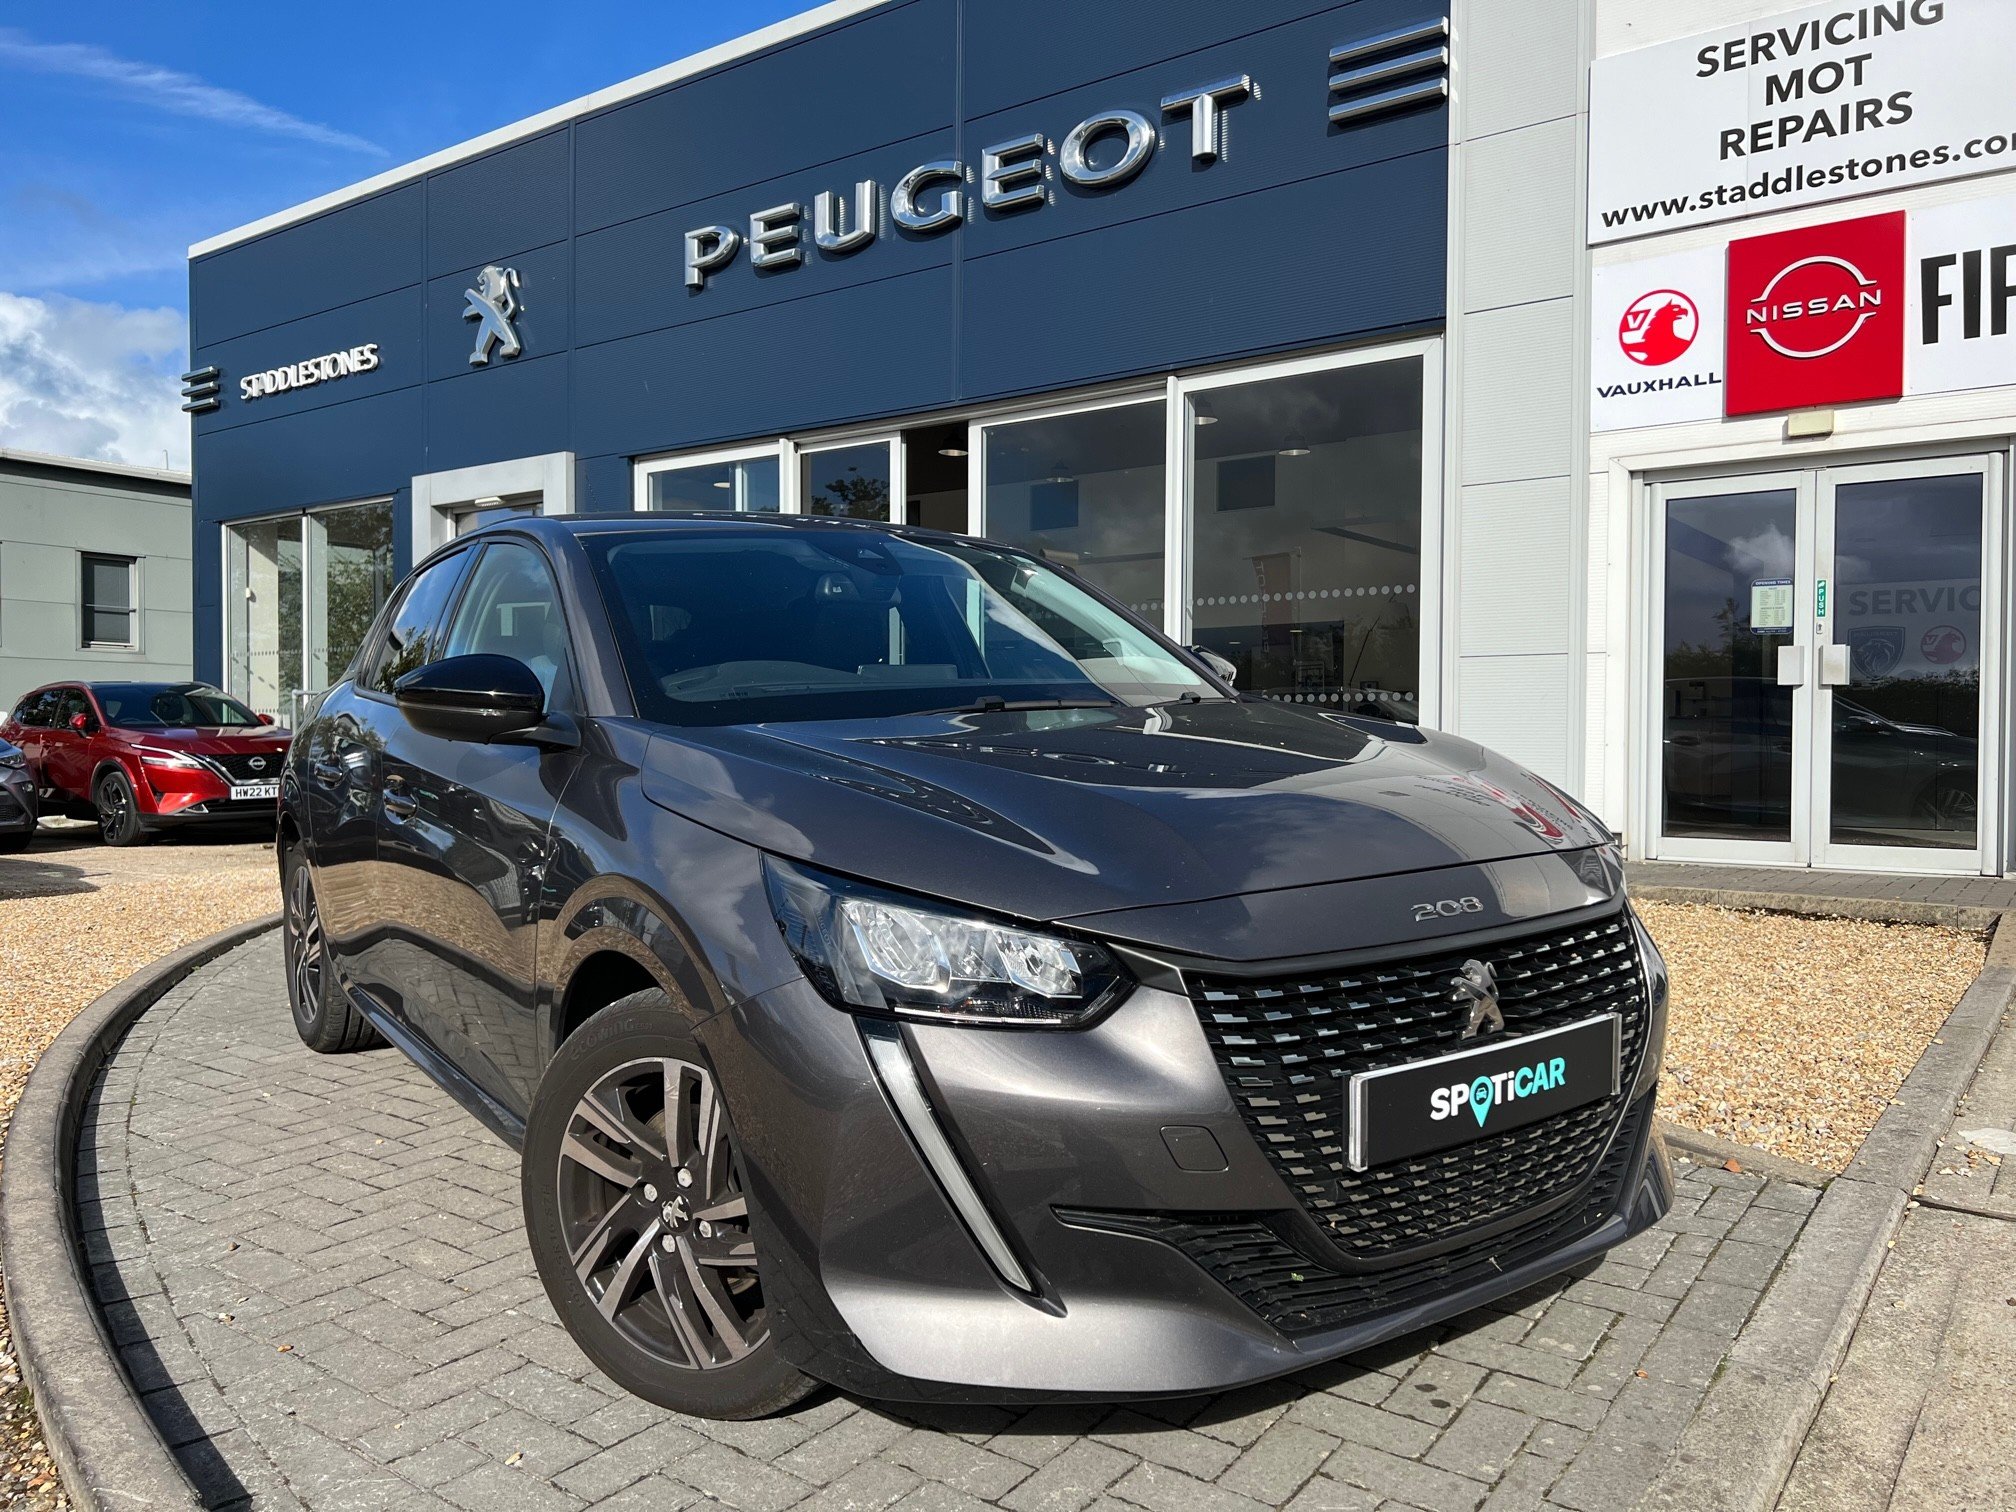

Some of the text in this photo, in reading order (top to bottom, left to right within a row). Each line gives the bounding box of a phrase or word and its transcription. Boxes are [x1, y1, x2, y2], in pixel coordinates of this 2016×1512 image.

[1696, 0, 1945, 77] SERVICING
[1765, 53, 1873, 106] MOT
[1720, 91, 1914, 160] REPAIRS
[684, 74, 1251, 289] PEUGEOT
[1601, 132, 2016, 228] www.staddlestones.co
[1746, 289, 1882, 325] NISSAN
[240, 343, 378, 400] STADDLESTONES
[1597, 372, 1722, 398] VAUXHALL
[1848, 585, 1979, 616] SERVIC
[235, 788, 262, 798] HW22
[1410, 896, 1484, 922] 208
